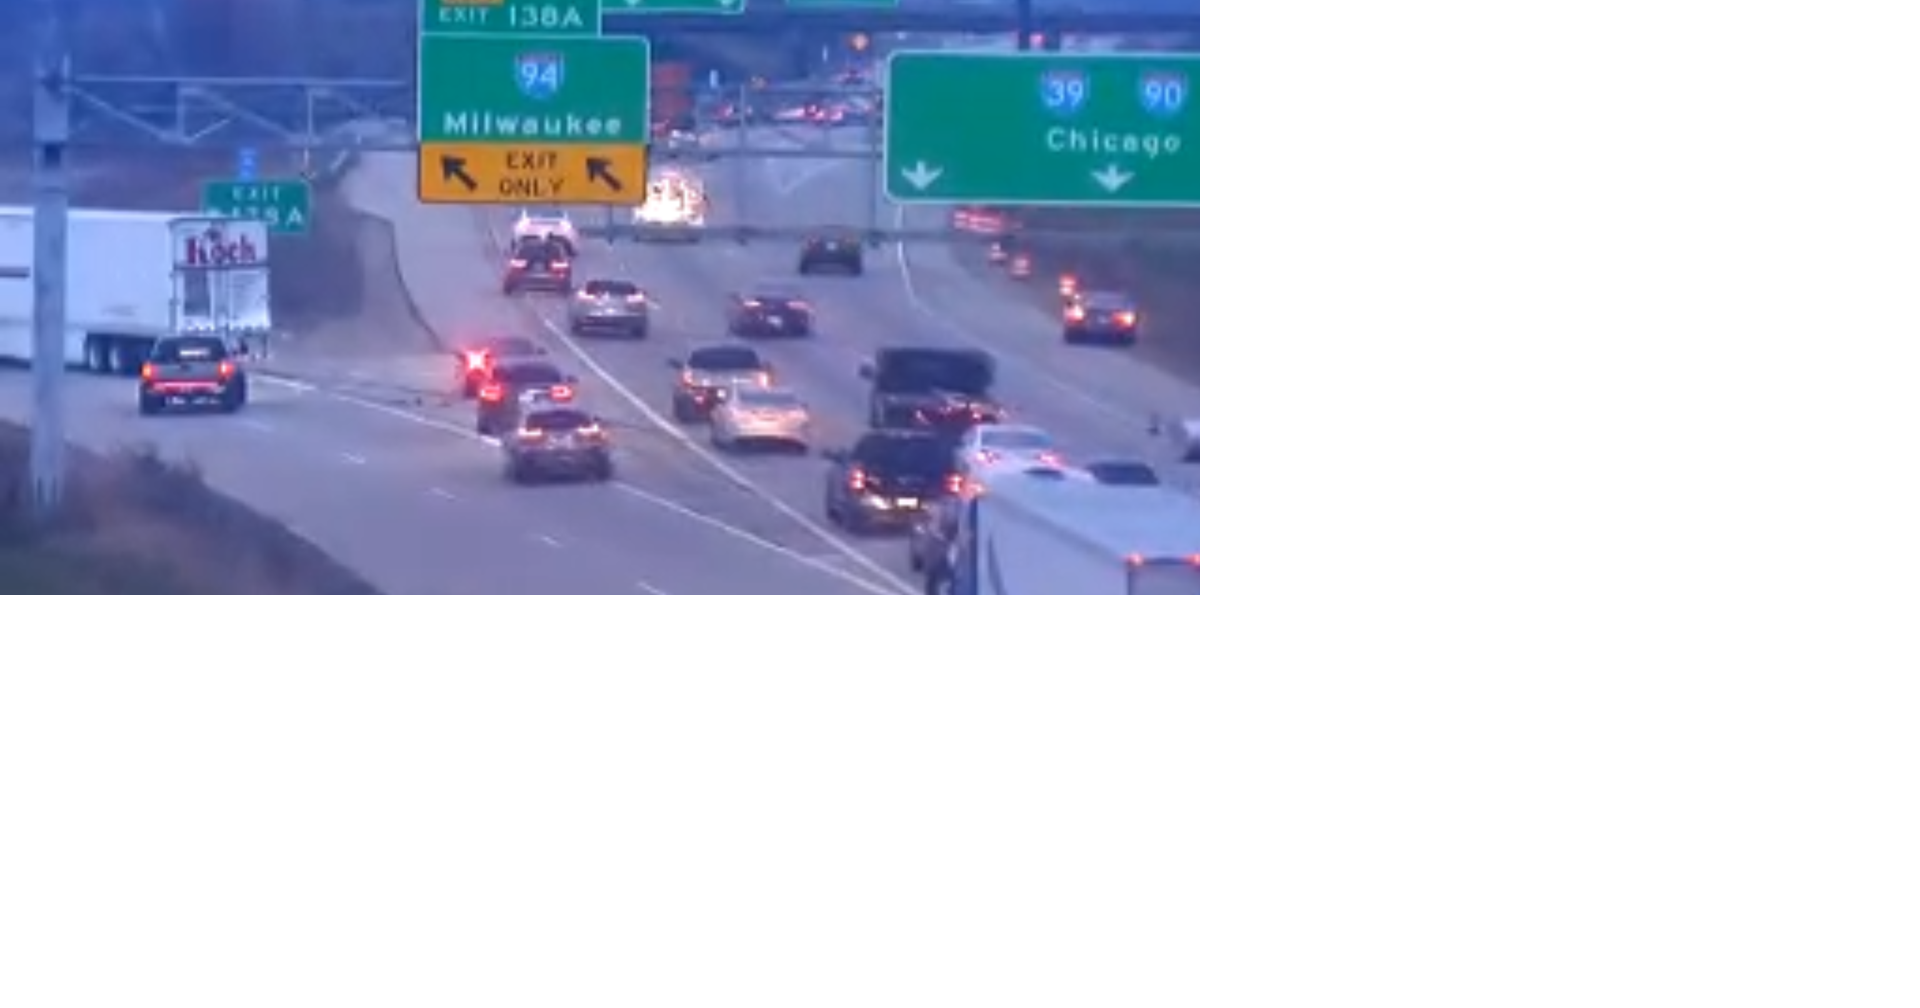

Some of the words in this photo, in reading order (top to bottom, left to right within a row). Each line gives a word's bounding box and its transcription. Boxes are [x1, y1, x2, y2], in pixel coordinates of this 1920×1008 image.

[438, 7, 490, 23] EXIT
[509, 4, 583, 28] 138A
[519, 62, 558, 90] 94
[1045, 80, 1085, 107] 39
[1143, 80, 1182, 107] 90
[442, 111, 623, 137] Milwaukee
[1045, 126, 1182, 157] Chicago
[505, 150, 559, 170] EXIT
[231, 184, 281, 202] EXIT
[498, 177, 564, 198] ONLY
[185, 233, 257, 265] Koch
